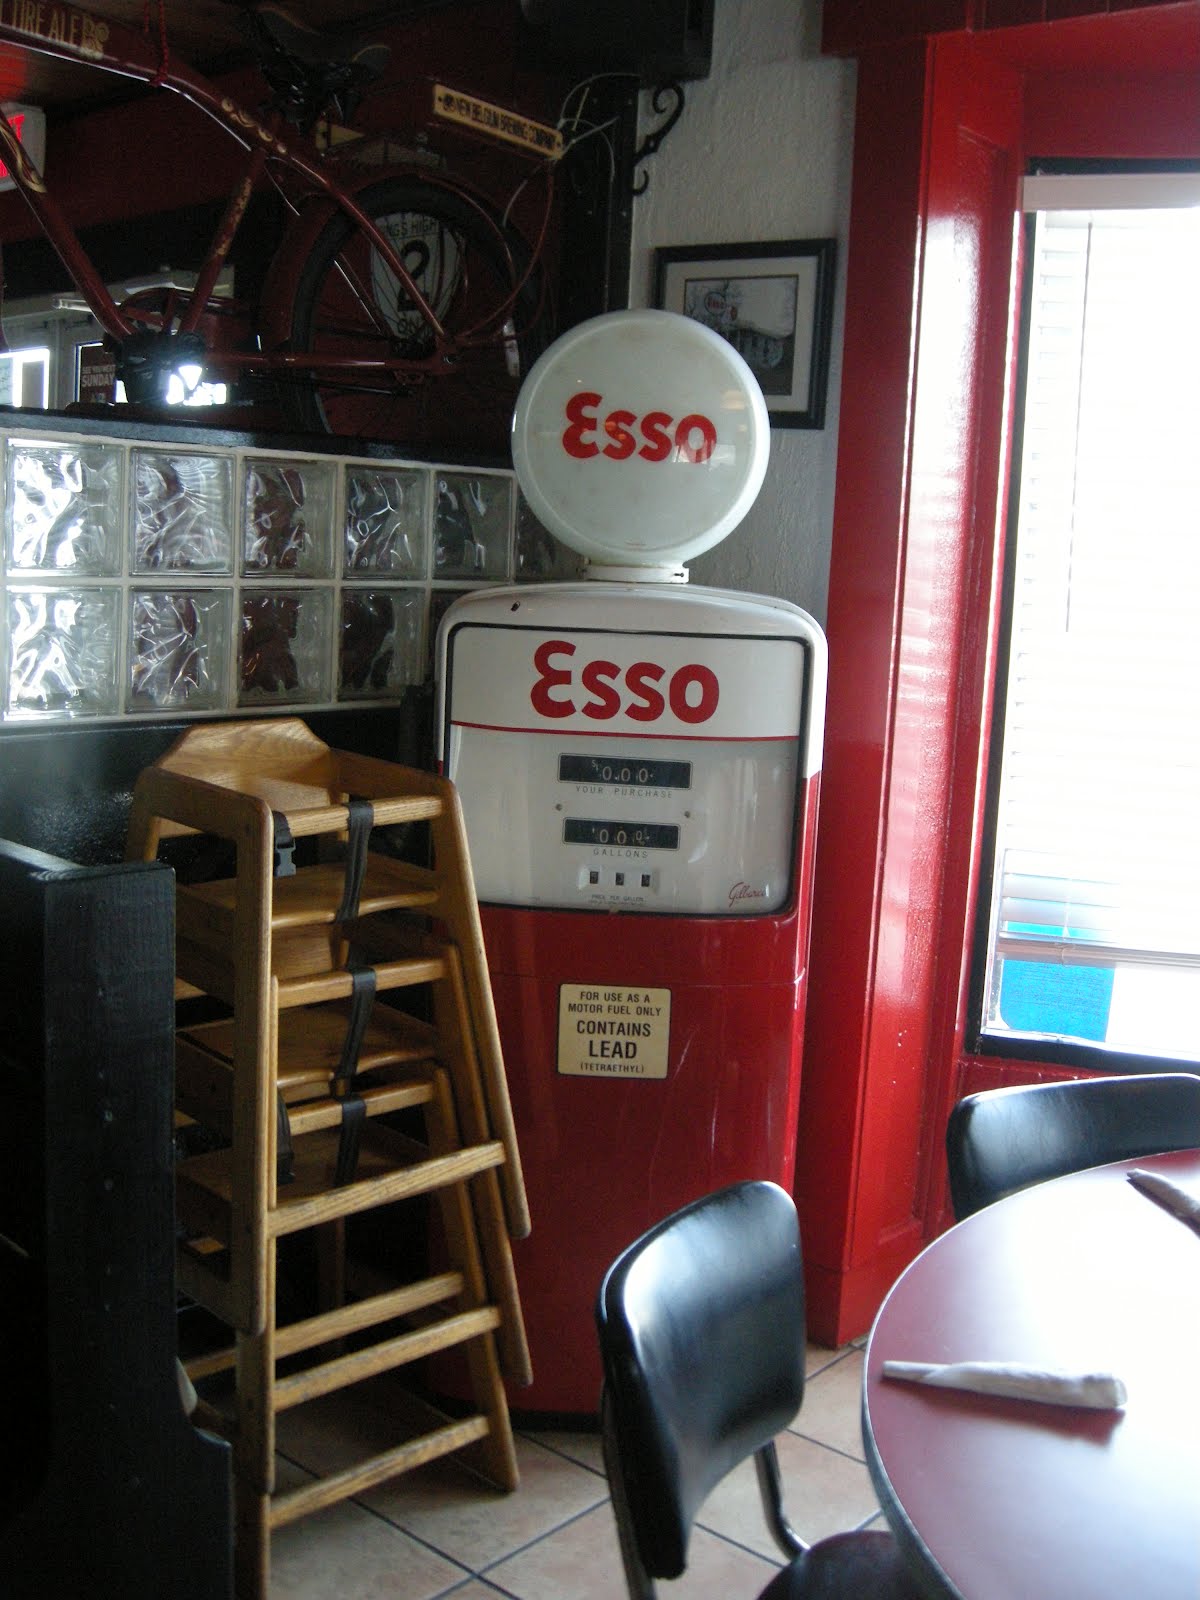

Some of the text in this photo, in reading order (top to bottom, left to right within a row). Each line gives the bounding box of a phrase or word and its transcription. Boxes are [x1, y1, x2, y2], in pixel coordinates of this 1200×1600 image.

[81, 373, 115, 388] SUNDAY
[575, 785, 673, 799] YOUR PURCHASE
[593, 848, 649, 859] GALLONS
[580, 991, 651, 1003] FOR USE AS A
[568, 1003, 661, 1016] MOTOR FUEL ONLY
[576, 1020, 651, 1037] CONTAINS
[589, 1040, 638, 1059] LEAD
[580, 1062, 645, 1074] (TETRAETHYL)
